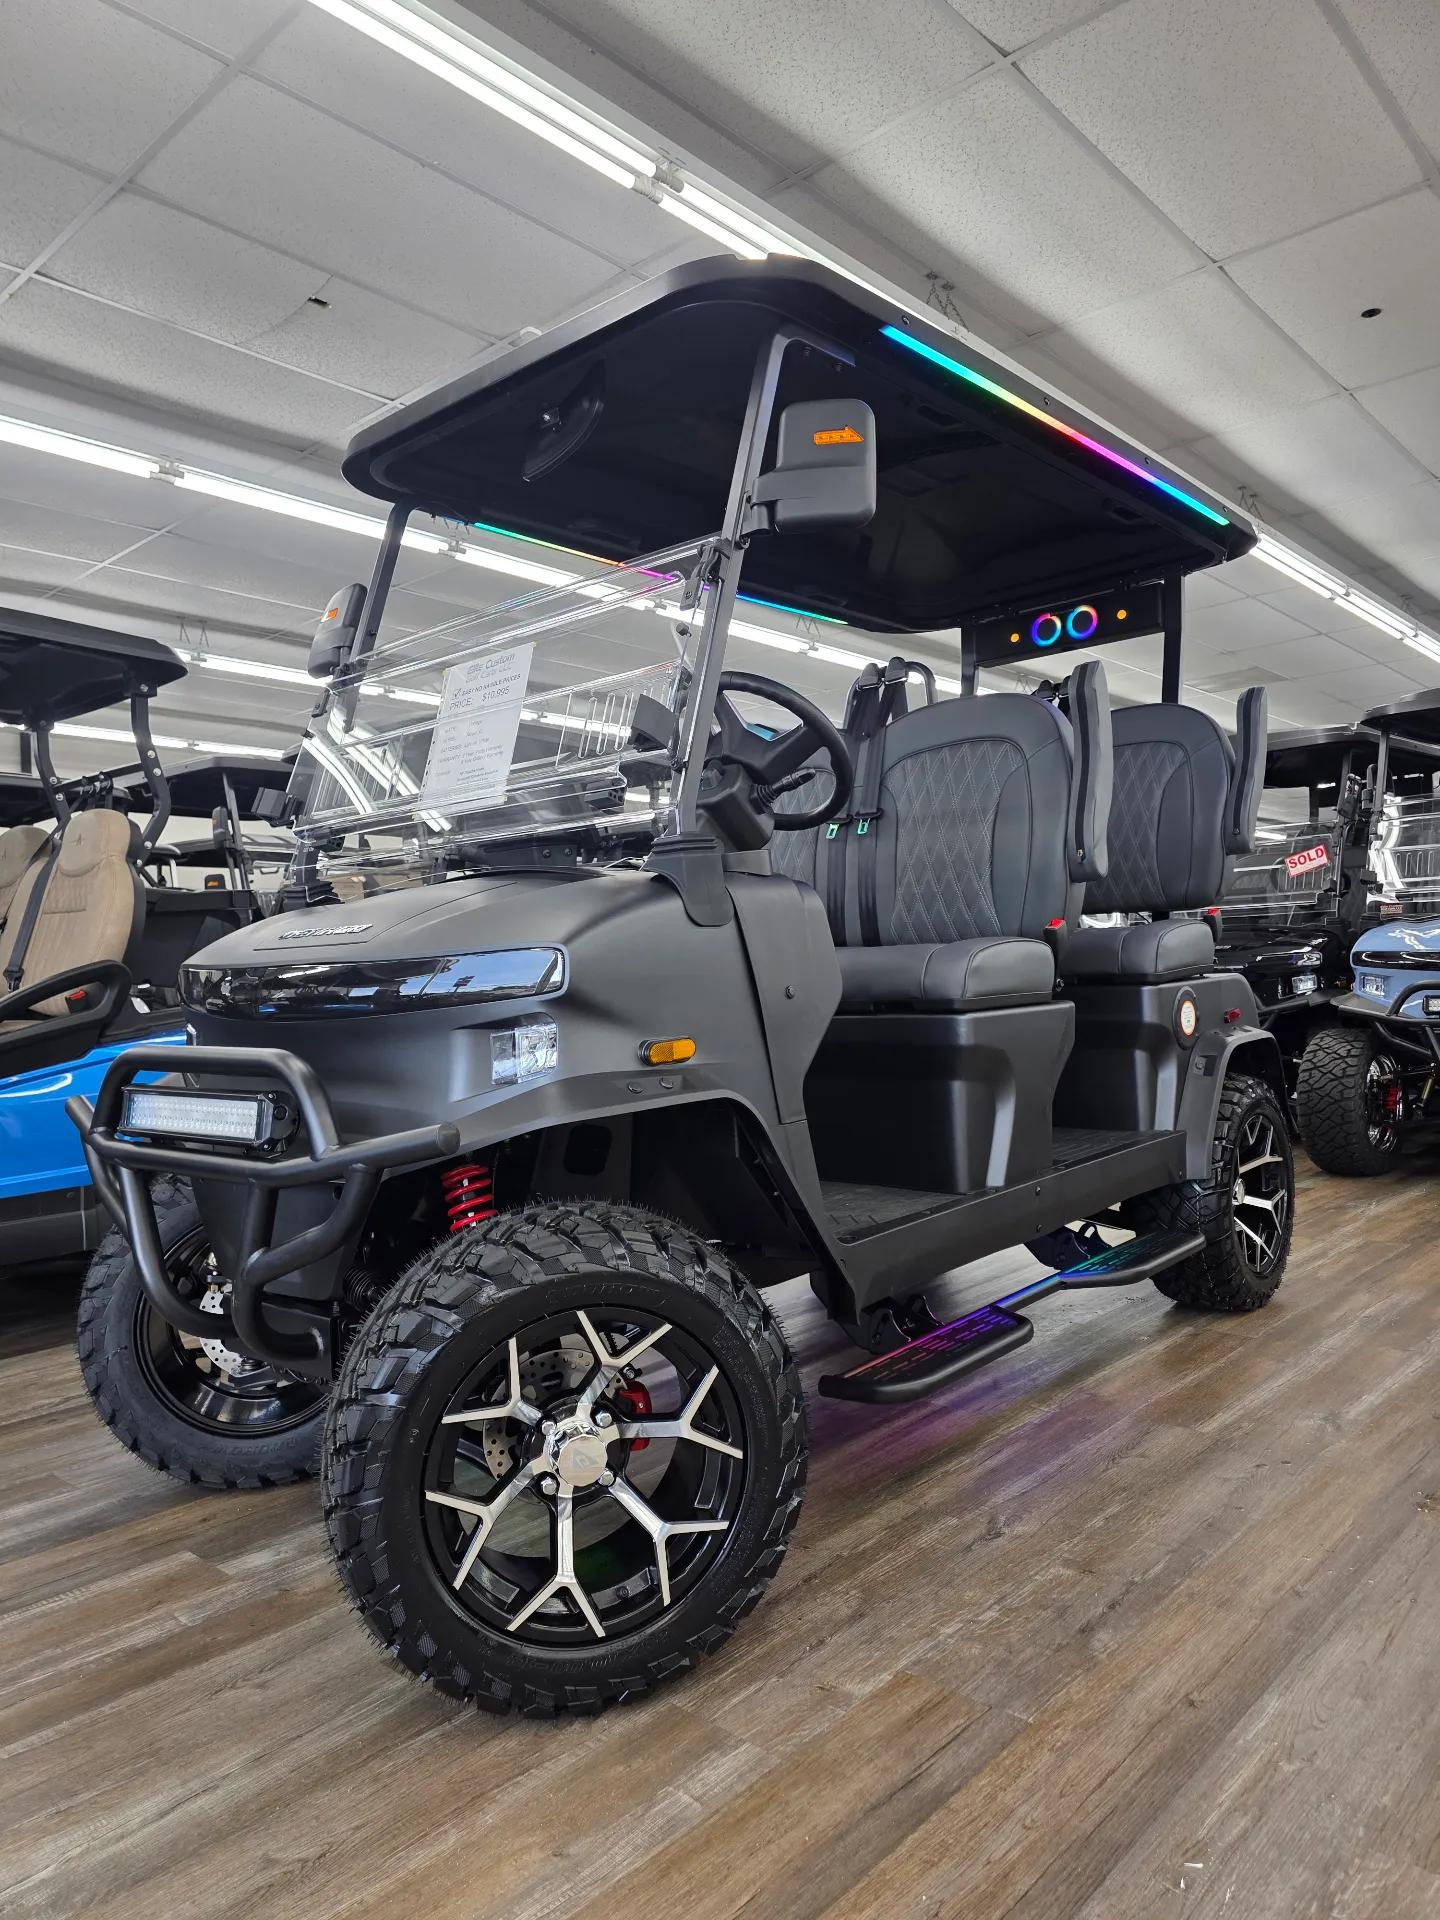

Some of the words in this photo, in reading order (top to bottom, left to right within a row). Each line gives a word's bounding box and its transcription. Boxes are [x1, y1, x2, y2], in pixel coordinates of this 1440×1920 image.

[467, 662, 484, 675] Elite
[485, 652, 516, 669] Custom
[499, 662, 512, 673] LLC
[461, 687, 473, 697] EASY
[501, 673, 521, 685] PRICES
[449, 697, 473, 711] PRICE:
[481, 686, 510, 702] $10,995
[1289, 848, 1324, 868] SOLD
